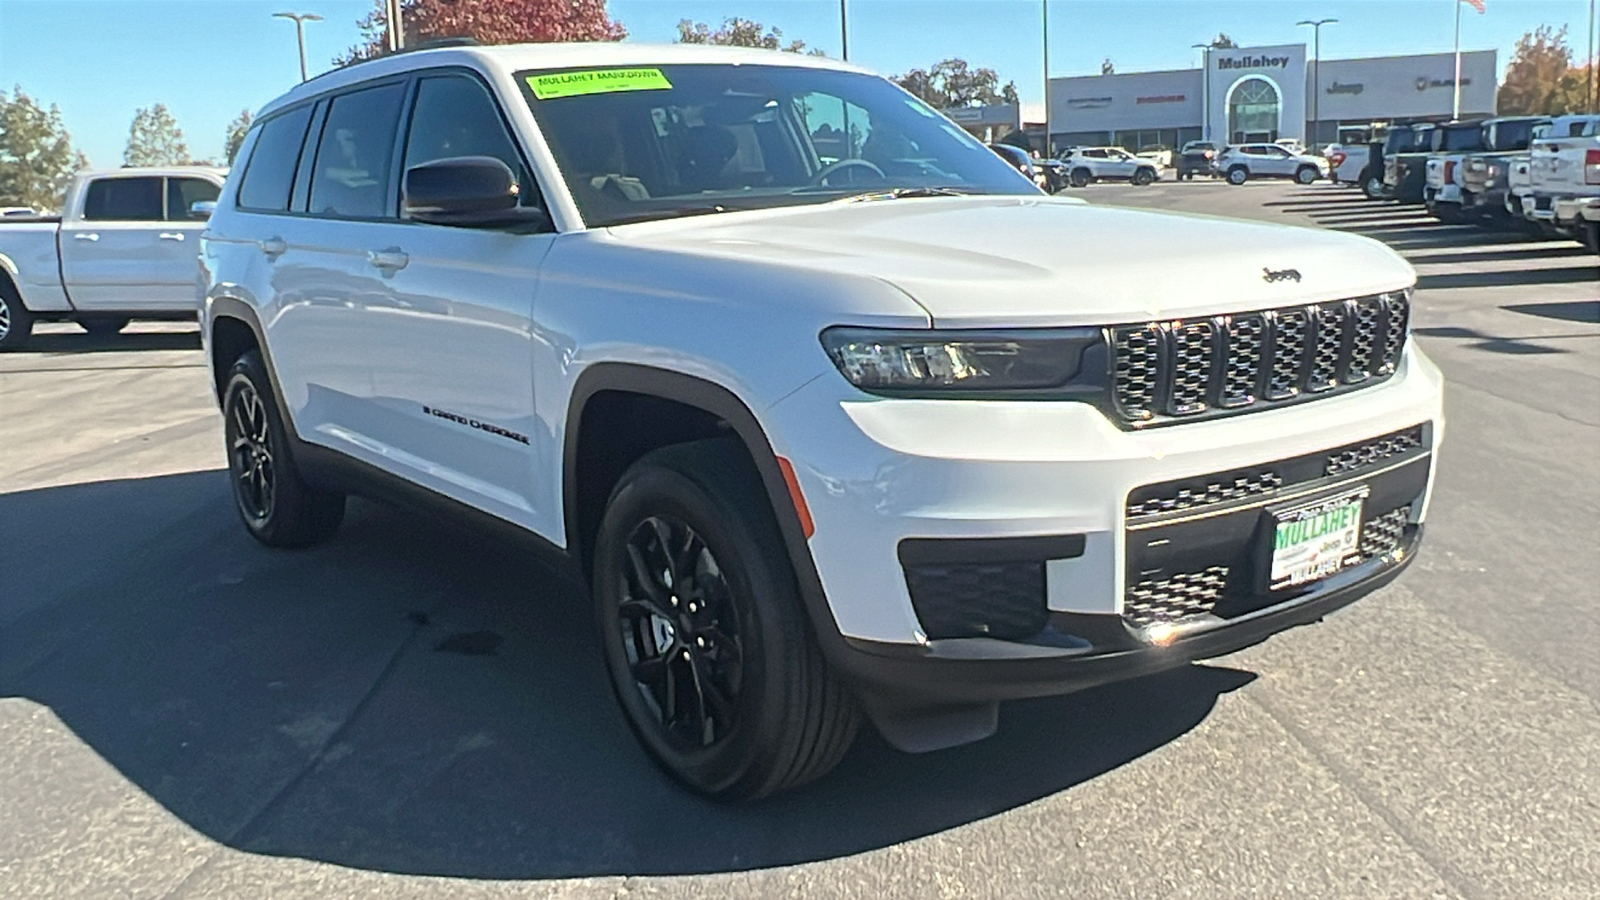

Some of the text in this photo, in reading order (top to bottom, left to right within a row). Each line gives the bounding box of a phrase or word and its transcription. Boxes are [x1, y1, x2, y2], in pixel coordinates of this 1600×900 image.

[1218, 55, 1289, 70] Mullahey
[538, 74, 594, 86] MULLAHEY
[598, 70, 659, 81] MARKDOWN
[1262, 266, 1302, 284] Jeep
[432, 408, 531, 446] GRAND CHEROKEE
[1276, 504, 1359, 548] MULLAHEY
